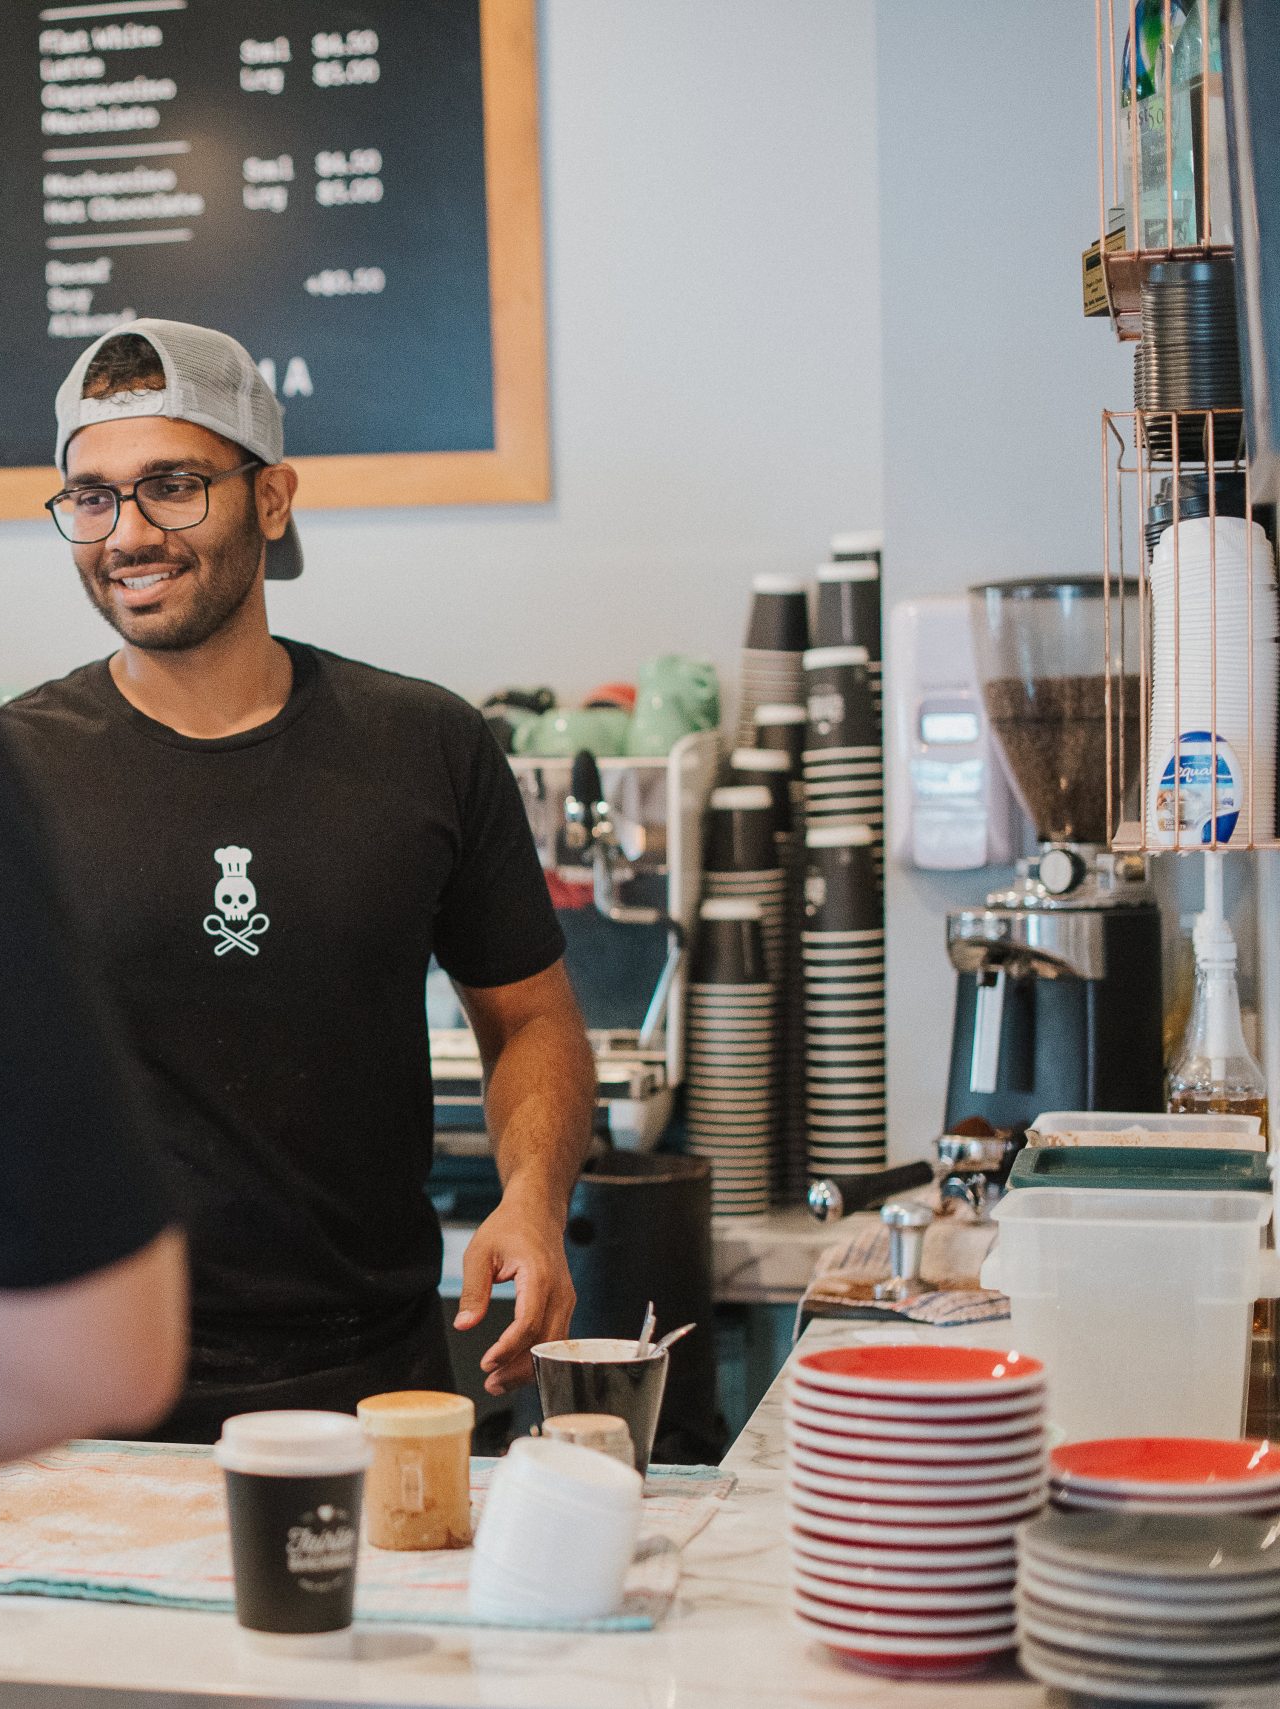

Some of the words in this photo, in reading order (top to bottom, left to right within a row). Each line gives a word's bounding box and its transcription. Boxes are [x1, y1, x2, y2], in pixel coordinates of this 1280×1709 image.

[39, 29, 90, 55] Flat
[91, 24, 163, 50] White
[240, 36, 291, 65] Sml
[312, 30, 379, 58] $4.50
[40, 57, 105, 82] Latte
[240, 67, 285, 94] Lrg
[312, 58, 380, 87] $5.00
[41, 76, 177, 109] Cappuccino
[41, 106, 160, 135] Macchiato
[243, 154, 295, 183] Sml
[315, 148, 382, 178] $4.50
[43, 200, 86, 224] Hot
[86, 192, 206, 220] Chocolate
[243, 184, 288, 213] Lrg
[316, 177, 384, 206] $5.00
[45, 257, 112, 286] Decaf
[47, 286, 94, 314] Soy
[1178, 765, 1215, 783] equa
